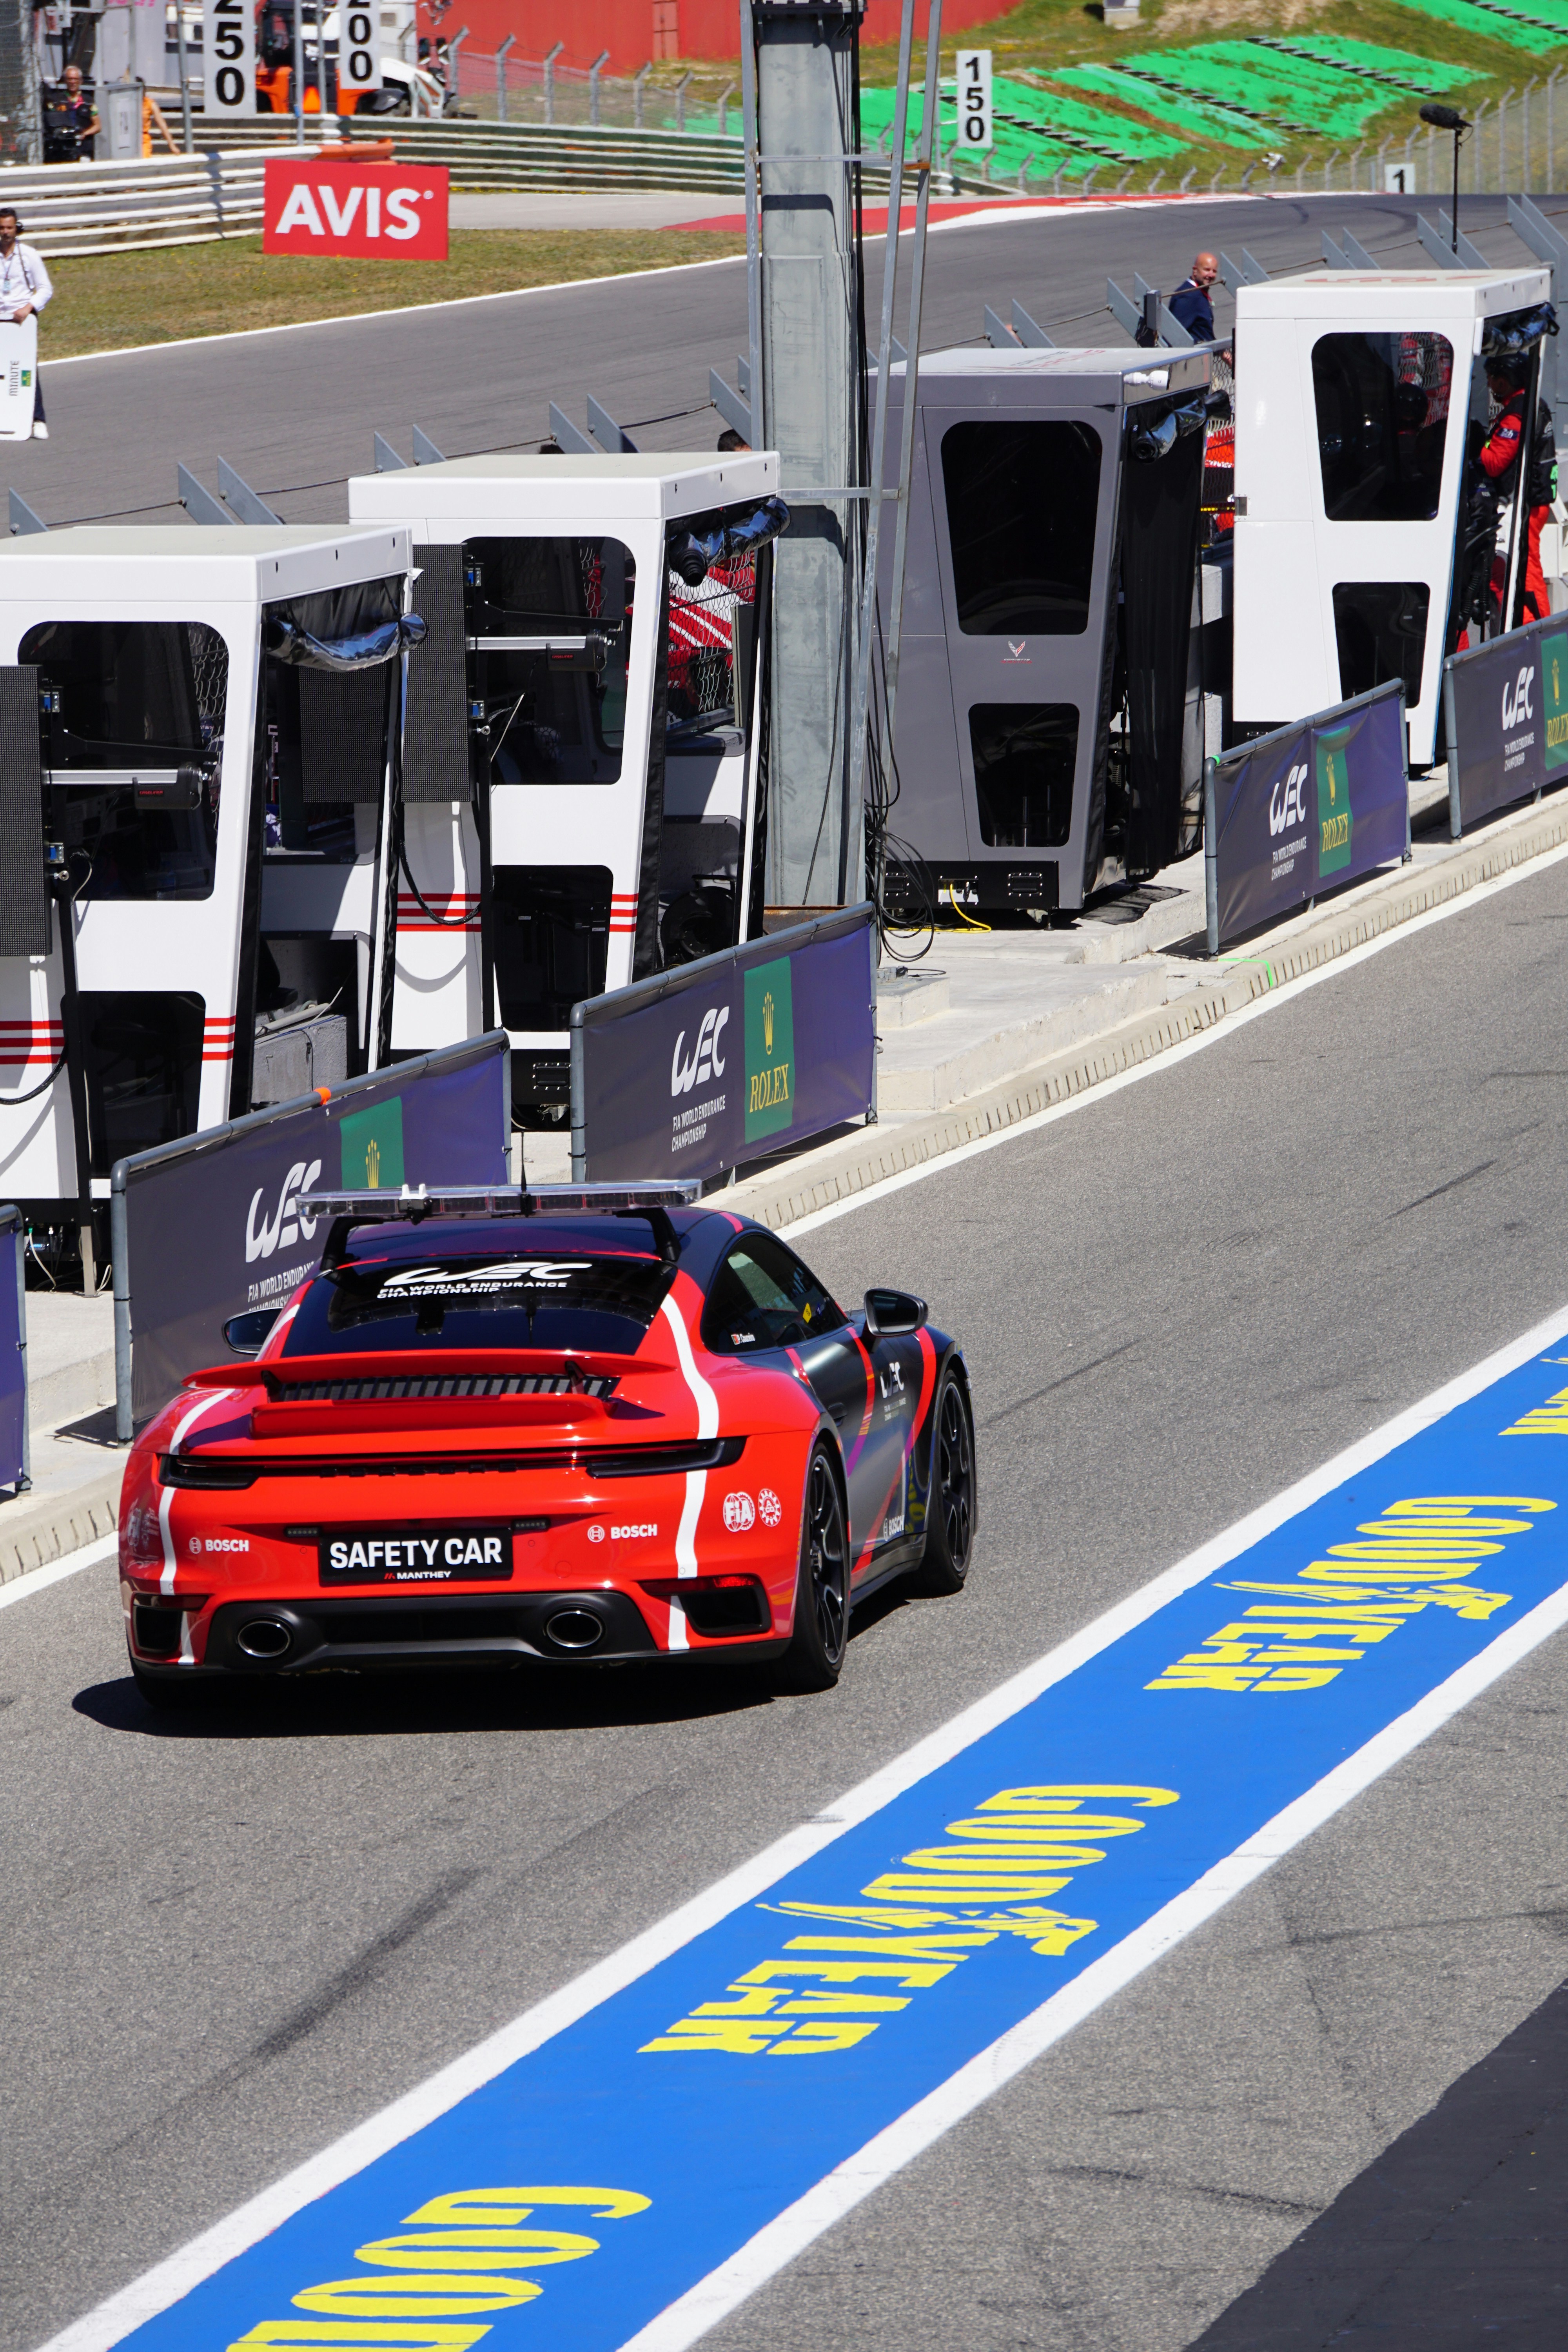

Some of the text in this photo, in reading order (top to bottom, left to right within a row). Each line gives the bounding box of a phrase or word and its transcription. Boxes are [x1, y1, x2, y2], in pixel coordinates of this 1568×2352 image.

[347, 0, 372, 82] 00
[965, 57, 984, 142] 150
[1393, 169, 1405, 194] 1
[1502, 666, 1534, 731] WEC
[1270, 764, 1308, 836] WEC
[1322, 813, 1348, 853] ROLEX
[671, 1006, 730, 1097] WEC
[750, 1063, 789, 1113] ROLEX
[681, 1107, 698, 1128] WORLD
[698, 1094, 726, 1121] ENDURANCE
[672, 1123, 707, 1152] CHAMPIONSHIP
[248, 1283, 259, 1303] FIA
[260, 1274, 283, 1298] WORLD
[384, 1262, 593, 1286] WEC
[409, 1283, 466, 1291] WORLD
[377, 1287, 501, 1299] CHAMPIONSHIP
[611, 1524, 657, 1539] BOSCH
[889, 1515, 905, 1536] BOSCH
[205, 1539, 249, 1552] BOSCH
[330, 1537, 503, 1569] SAFETY CAR
[397, 1571, 451, 1579] MANTHEY
